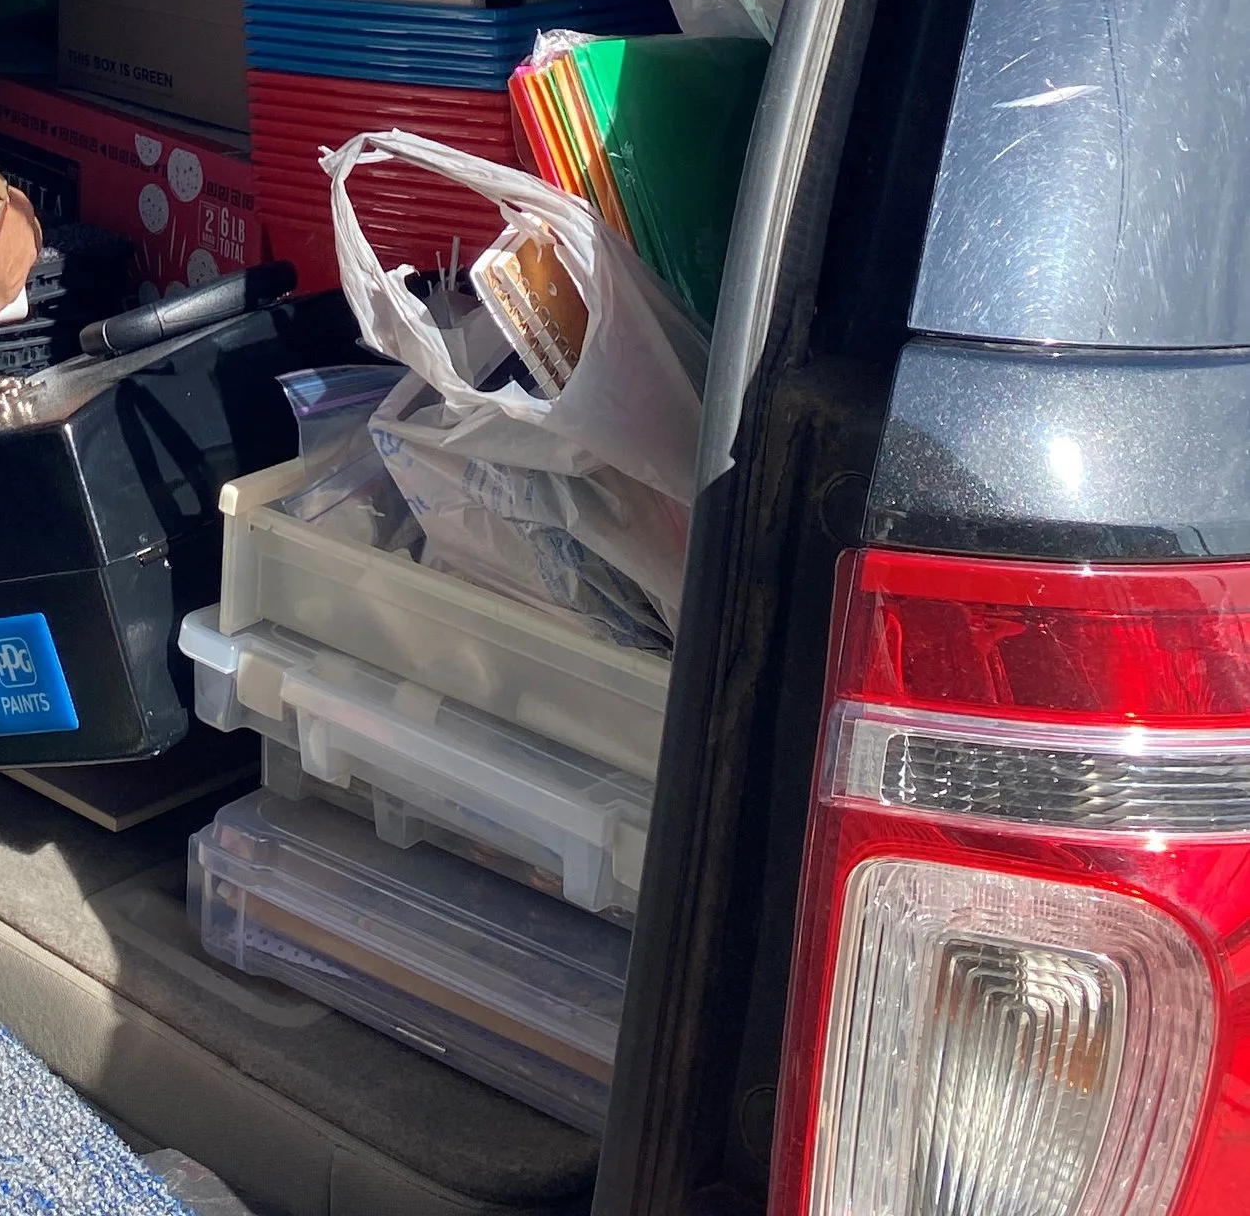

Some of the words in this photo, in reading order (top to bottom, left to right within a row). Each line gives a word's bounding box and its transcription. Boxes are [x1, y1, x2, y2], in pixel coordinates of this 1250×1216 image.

[67, 48, 90, 67] THIS
[93, 55, 117, 75] BOX
[119, 62, 130, 77] IS
[133, 66, 173, 88] GREEN
[205, 209, 214, 233] 2
[221, 207, 229, 238] 6
[231, 215, 245, 243] LB
[220, 237, 245, 264] TOTAL
[0, 692, 50, 716] PAINTS
